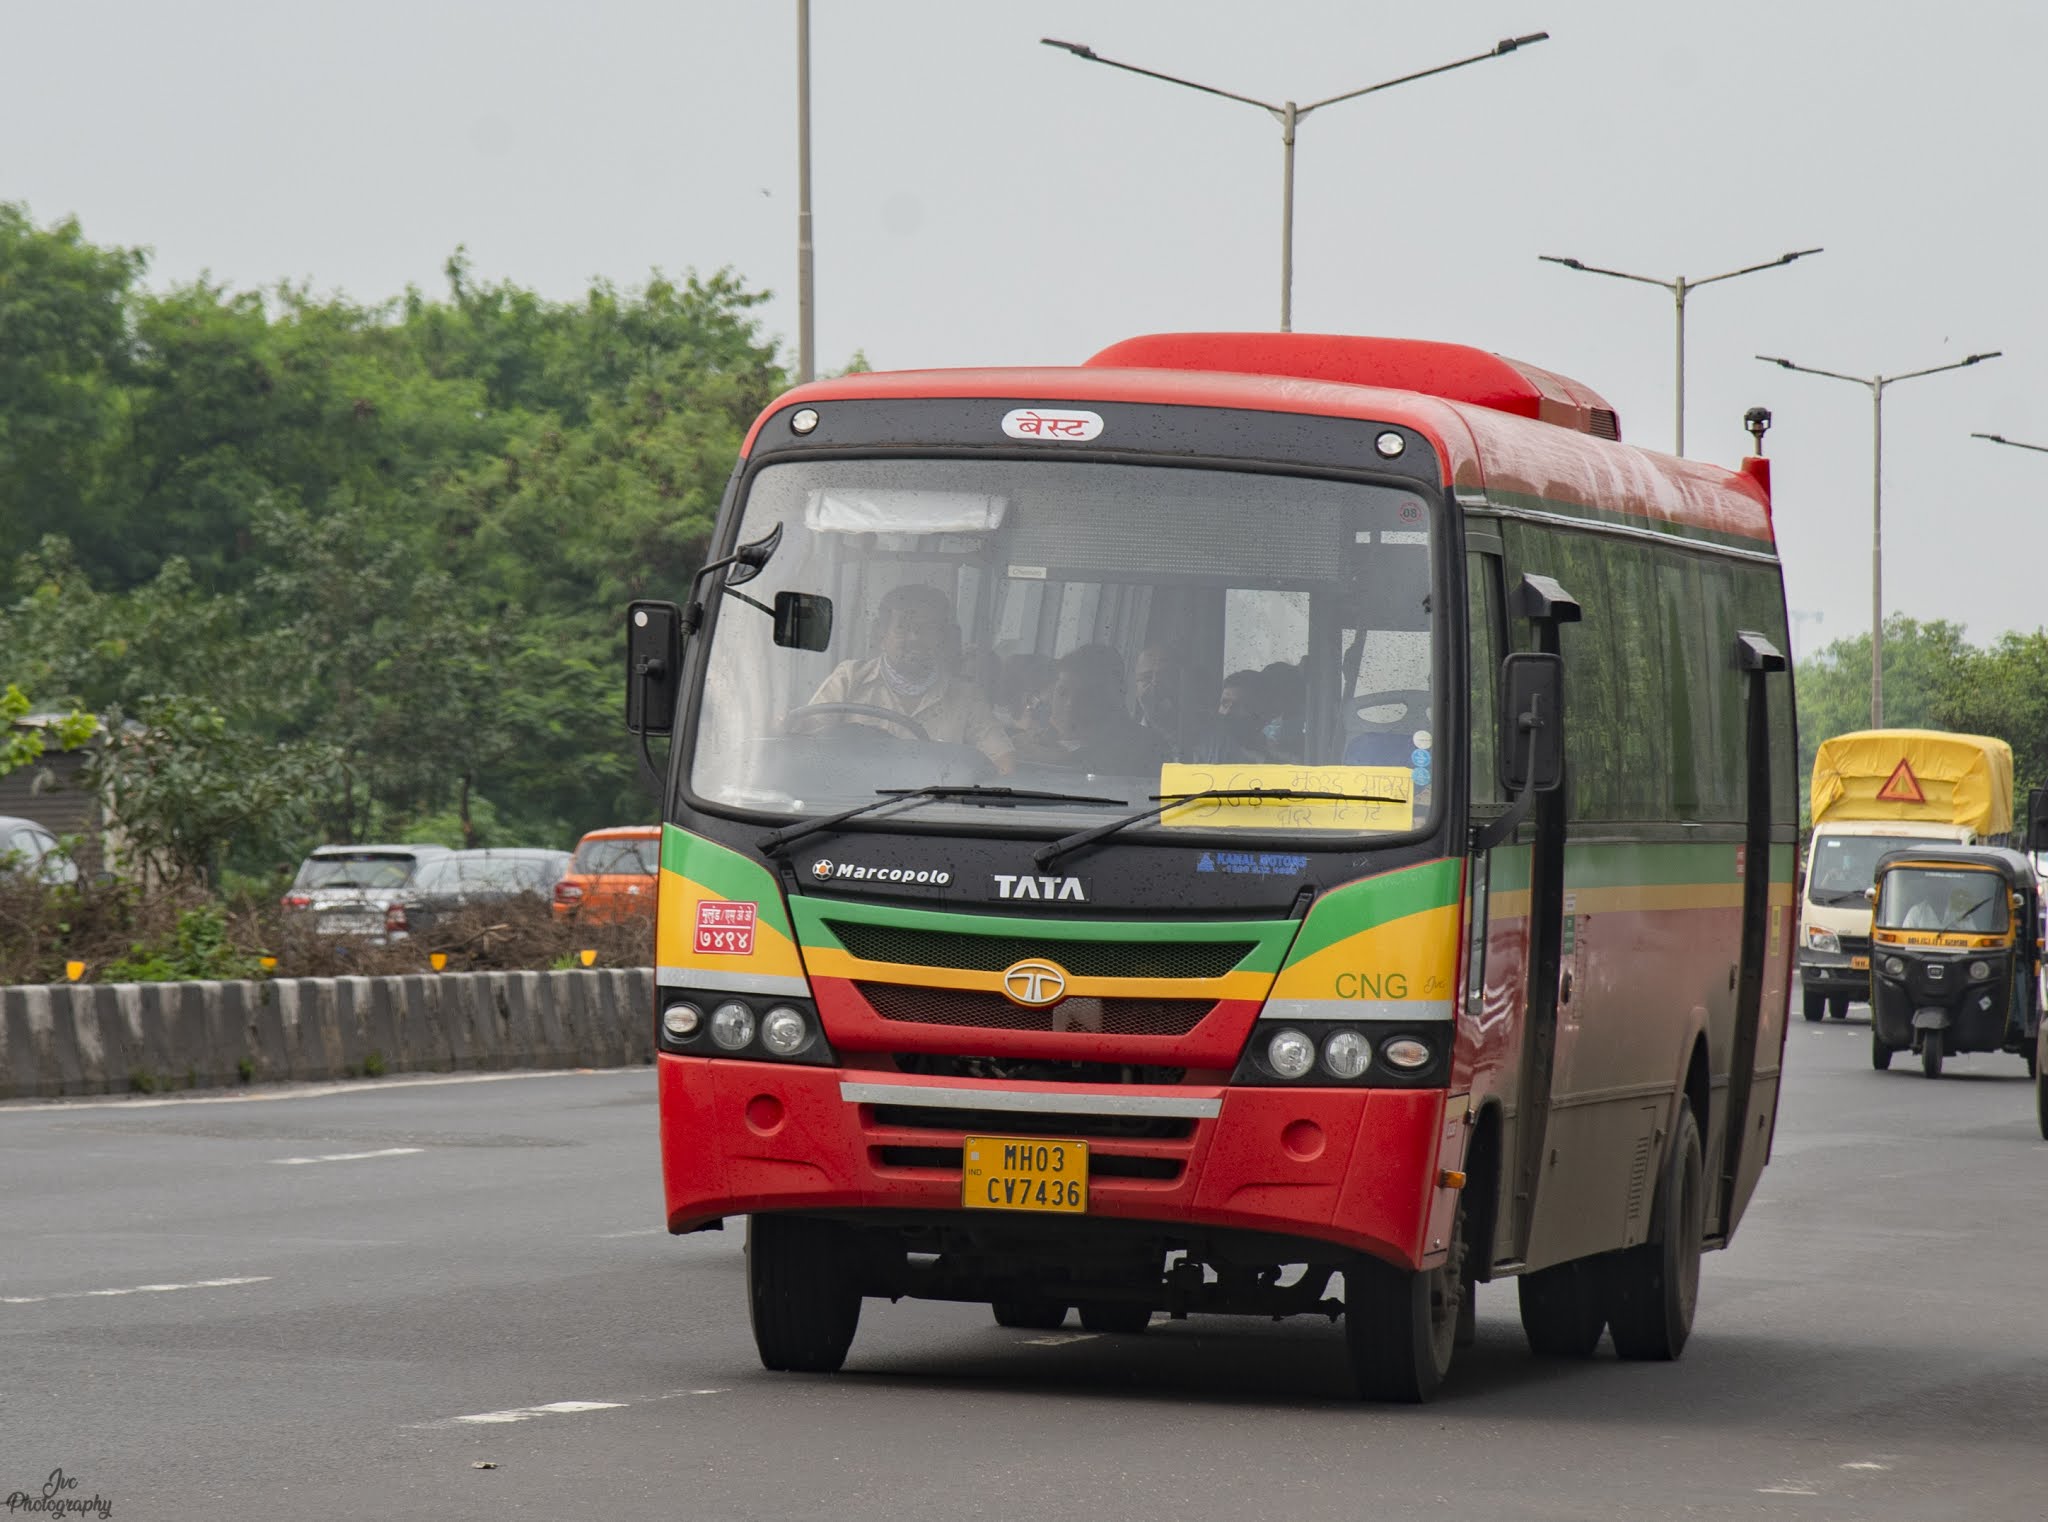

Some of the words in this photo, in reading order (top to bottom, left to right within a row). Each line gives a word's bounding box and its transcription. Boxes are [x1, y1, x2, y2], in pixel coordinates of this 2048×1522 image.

[1016, 411, 1090, 437] बेस्ट
[836, 863, 950, 885] Marcopolo
[994, 874, 1085, 900] TATA
[700, 931, 749, 951] ७४१४
[1335, 973, 1408, 999] CNG
[1004, 1144, 1065, 1172] MH03
[987, 1177, 1080, 1207] CV7436
